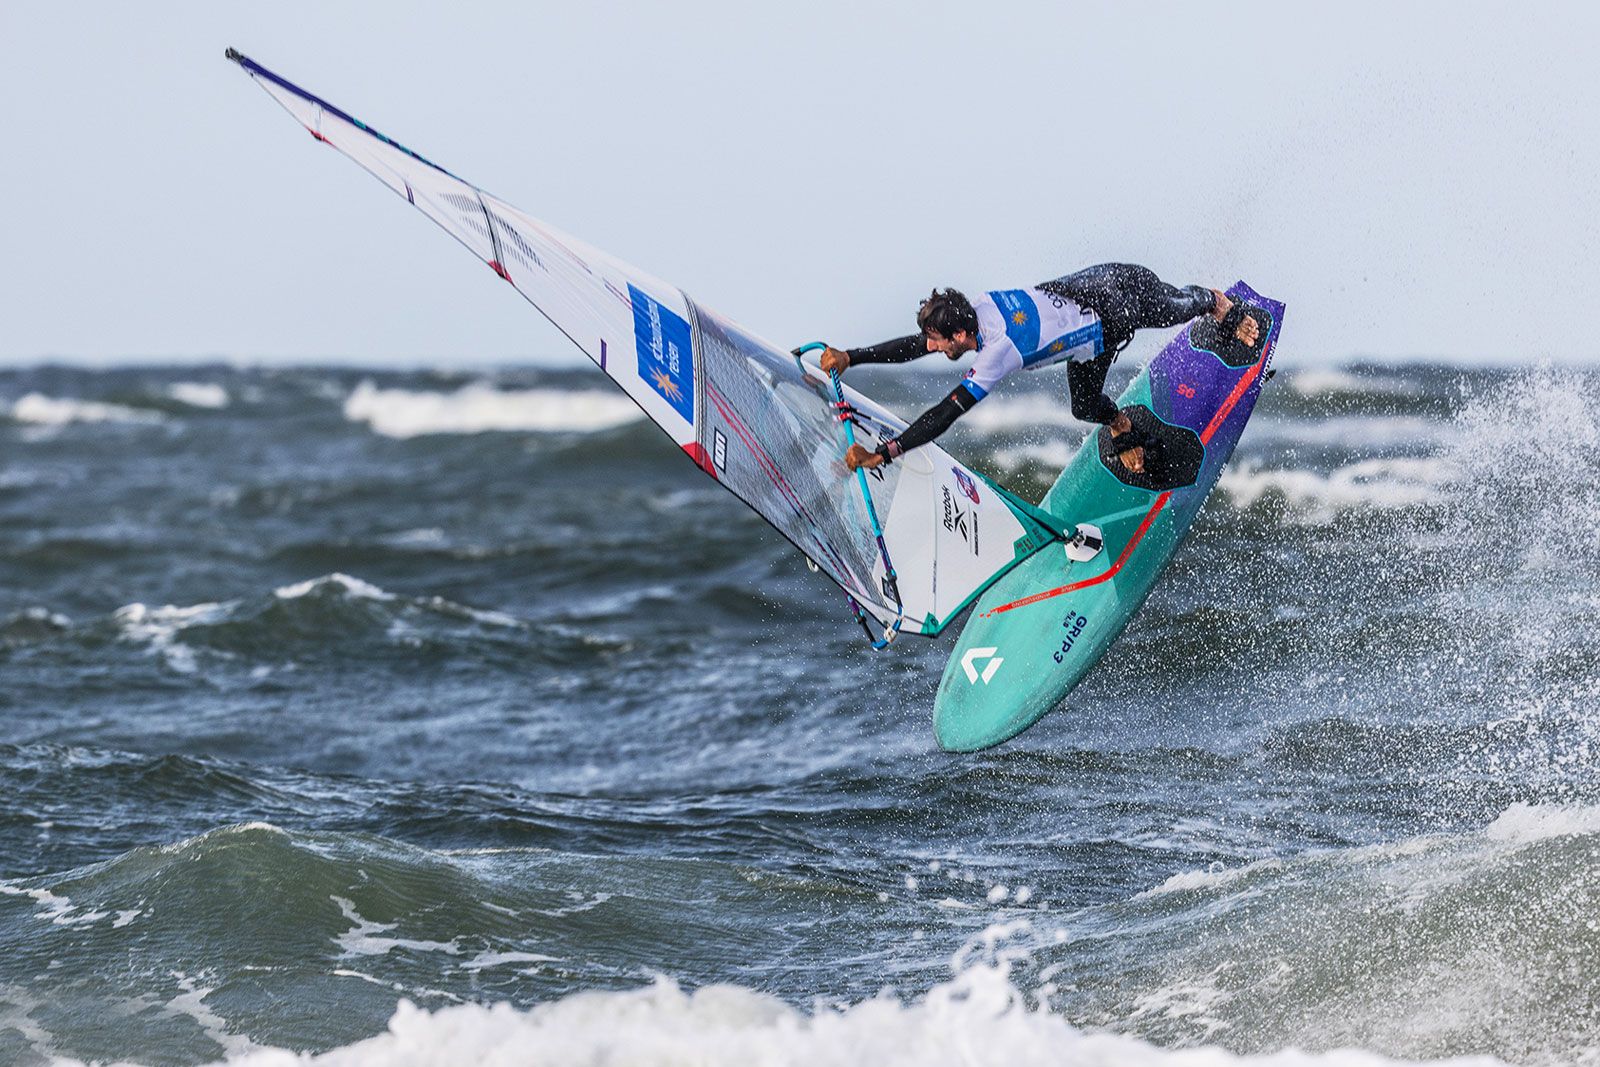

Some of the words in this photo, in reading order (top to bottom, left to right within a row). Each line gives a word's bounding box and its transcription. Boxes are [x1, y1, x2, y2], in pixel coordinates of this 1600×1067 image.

[1177, 383, 1196, 399] 95
[1062, 616, 1087, 652] GRIP
[1053, 651, 1063, 664] 3
